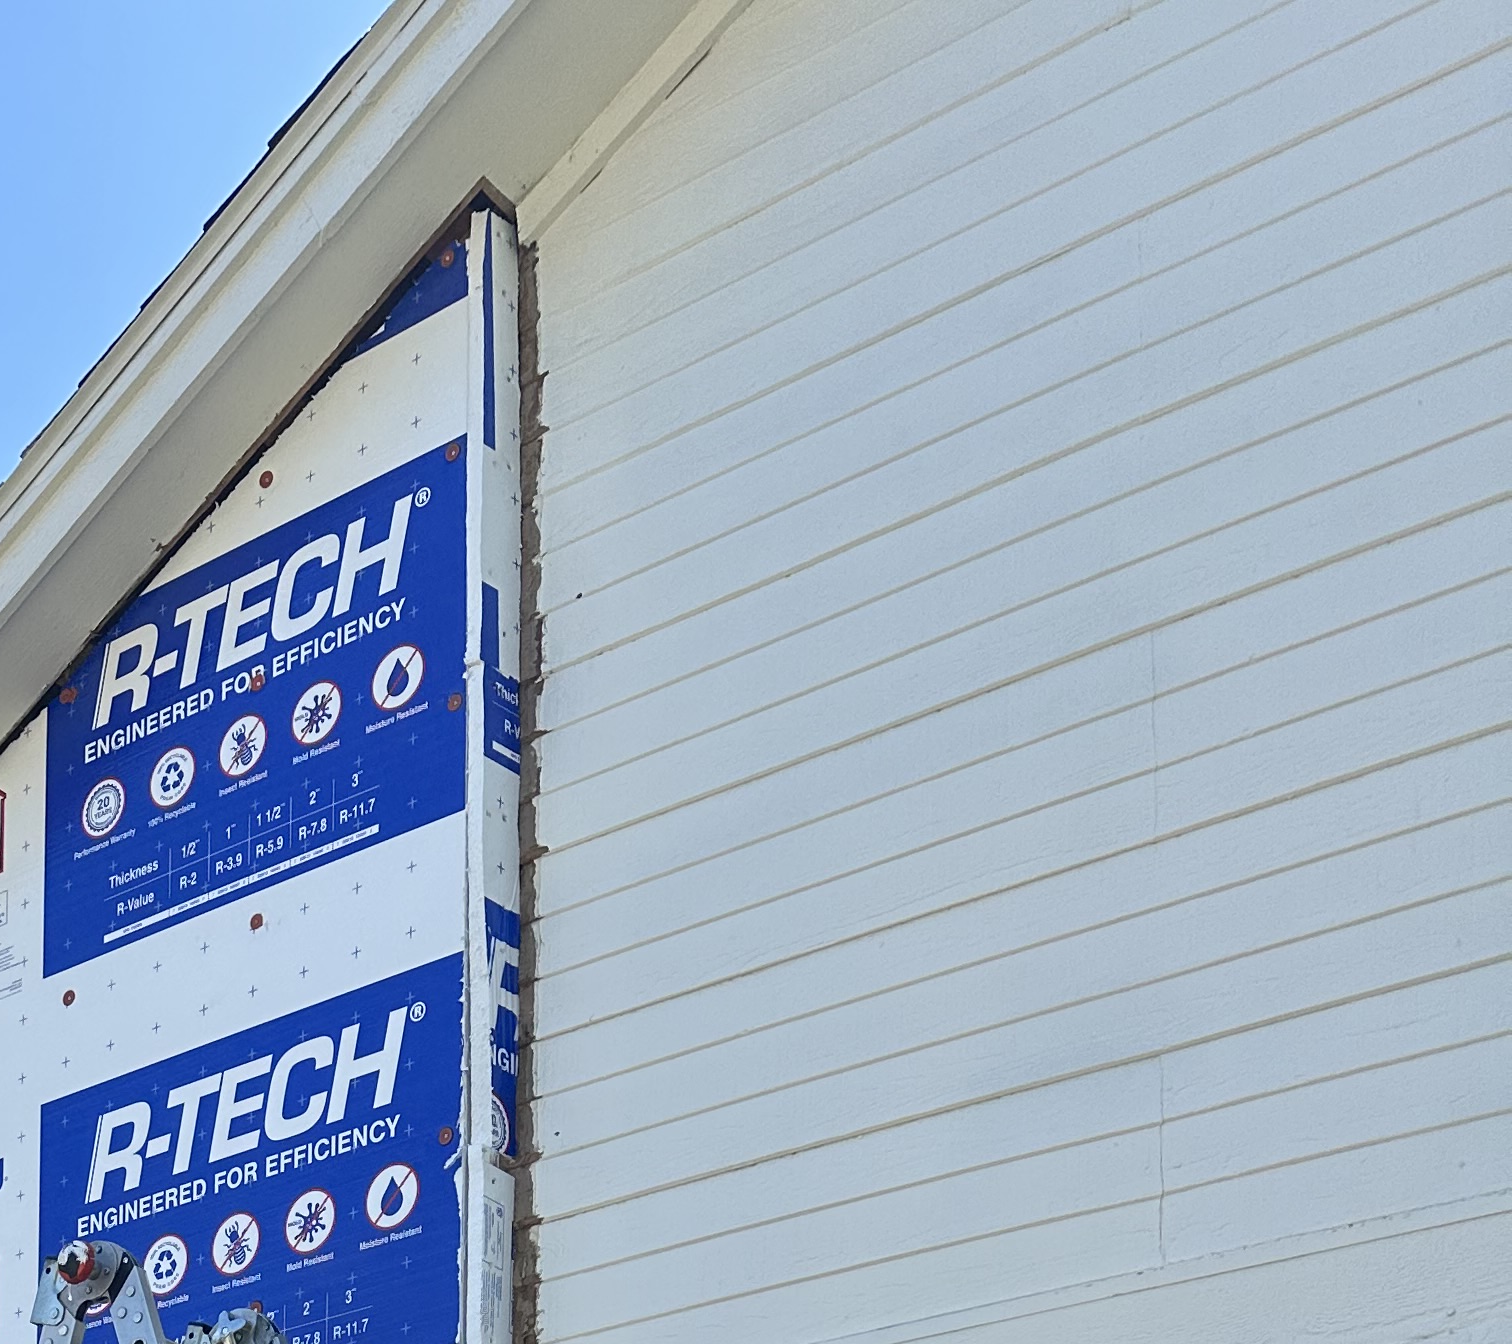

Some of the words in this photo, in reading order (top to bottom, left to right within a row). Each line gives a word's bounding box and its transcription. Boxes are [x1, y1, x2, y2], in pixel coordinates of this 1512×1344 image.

[83, 688, 215, 765] ENGINEERED
[272, 597, 406, 679] EFFICIENCY
[365, 716, 395, 734] Moisture
[396, 702, 430, 723] Resistant
[292, 752, 309, 765] Mold
[310, 739, 341, 760] Resistant
[218, 784, 238, 797] Insect
[239, 771, 268, 791] Resistant
[94, 806, 114, 820] YEARS
[96, 795, 110, 810] 20
[164, 801, 197, 823] Recyclable
[73, 838, 110, 861] Performance
[110, 828, 136, 847] Warranty
[116, 892, 155, 916] R-Value
[179, 872, 197, 889] R-2
[215, 853, 243, 875] R-3.9
[255, 836, 285, 858] R-5.9
[298, 818, 328, 840] R-7.8
[339, 798, 376, 824] R-11.7
[109, 860, 159, 890] Thickness
[76, 1176, 208, 1239] ENGINEERED
[214, 1161, 258, 1197] FOR
[264, 1114, 402, 1180] EFFICIENCY
[359, 1236, 389, 1251] Moisture
[390, 1224, 423, 1244] Resistant
[287, 1260, 304, 1272] Mold
[304, 1252, 335, 1270] Resistant
[211, 1282, 232, 1295] Insect
[233, 1273, 262, 1290] Resistant
[333, 1318, 369, 1341] R-11.7
